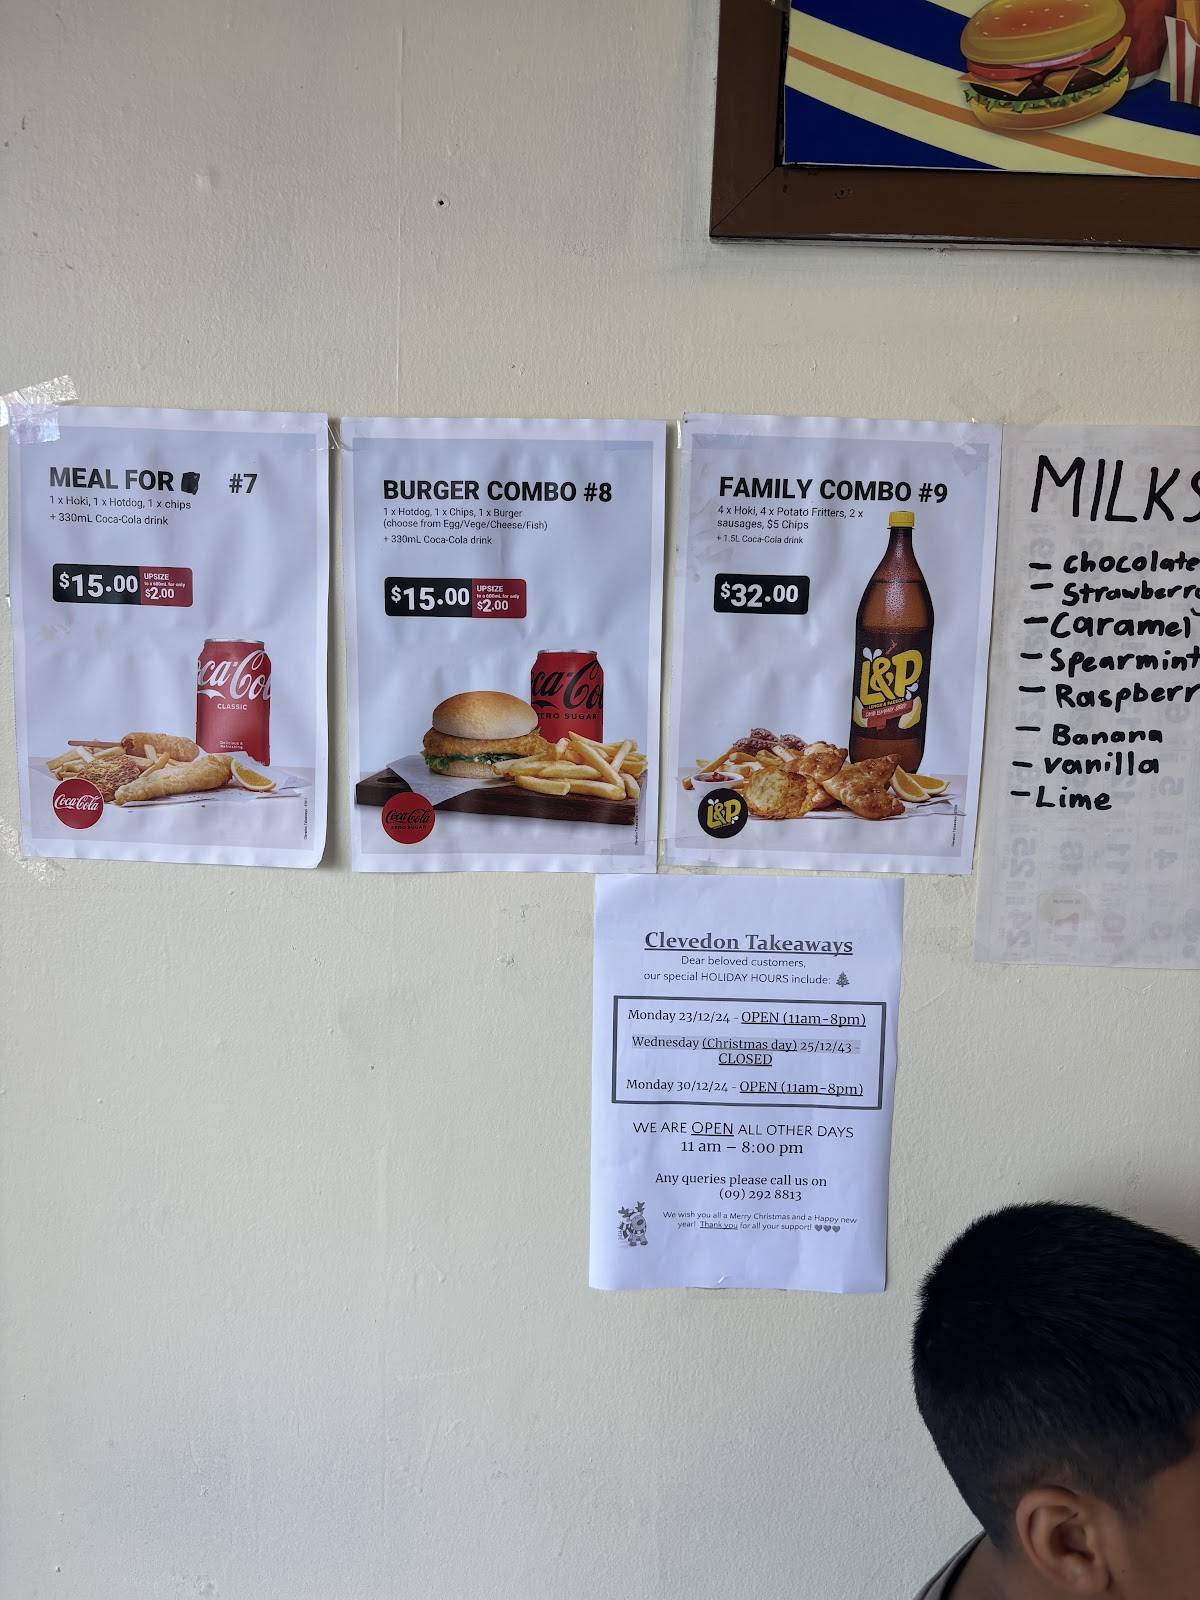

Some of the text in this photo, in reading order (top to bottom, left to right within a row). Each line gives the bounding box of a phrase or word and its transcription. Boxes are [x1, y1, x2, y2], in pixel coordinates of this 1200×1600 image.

[50, 467, 258, 494] MEAL FOR #7
[383, 480, 612, 502] BURGER COMBO #8
[719, 476, 948, 503] FAMILY COMBO #9
[50, 495, 54, 504] 1
[66, 496, 91, 507] Hoki,
[93, 498, 98, 506] 1
[109, 498, 145, 509] Hotdog,
[165, 500, 192, 511] chips
[59, 513, 92, 523] 330mL
[95, 514, 142, 524] Coca-Cola
[144, 516, 169, 525] drink
[384, 507, 388, 516] 1
[399, 507, 432, 518] Hotdog,
[435, 508, 439, 516] 1
[449, 508, 476, 518] Chips,
[479, 508, 483, 517] 1
[494, 508, 523, 519] Burger
[717, 505, 724, 514] 4
[734, 506, 758, 517] Hoki,
[760, 507, 766, 515] 4
[777, 507, 809, 516] Potato
[812, 508, 847, 519] Fritters,
[849, 509, 855, 518] 2
[383, 519, 548, 531] (choose from Egg/Vege/Cheese/Fish)
[717, 519, 809, 531] sausages, $5 Chips
[391, 535, 421, 544] 330mL
[424, 535, 468, 544] Coca-Cola
[470, 536, 492, 545] drink
[724, 535, 740, 543] 1.5L
[742, 535, 782, 544] Coca-Cola
[784, 536, 803, 544] drink
[59, 571, 139, 598] $15.00
[145, 587, 174, 600] $2.00
[391, 585, 470, 611] $15.00
[720, 582, 799, 607] $32.00
[477, 599, 509, 612] $2.00
[1050, 612, 1190, 639] Caramel
[1050, 645, 1200, 677] Spearmint
[860, 649, 922, 705] L&P
[217, 703, 248, 711] CLASSIC
[1052, 723, 1163, 745] Banana
[1036, 786, 1112, 810] Lime
[706, 799, 741, 828] L&P
[644, 931, 853, 957] Clevedon Takeaways
[681, 955, 806, 968] Dear beloved customers,
[644, 971, 831, 984] our special HOLIDAY HOURS include:
[628, 1009, 676, 1023] Monday
[679, 1011, 729, 1024] 23/12/24
[741, 1011, 779, 1023] OPEN
[632, 1036, 699, 1050] Wednesday
[702, 1037, 768, 1050] (Christmas
[771, 1039, 797, 1052] day)
[800, 1041, 852, 1053] 25/12/43
[718, 1052, 772, 1065] CLOSED
[626, 1079, 674, 1092] Monday
[677, 1081, 728, 1092] 30/12/24
[740, 1081, 777, 1092] OPEN
[632, 1122, 854, 1138] WE ARE OPEN ALL OTHER DAYS
[681, 1141, 693, 1152] 11
[698, 1144, 721, 1152] am
[741, 1141, 775, 1154] 8:00
[779, 1144, 803, 1156] pm
[655, 1173, 827, 1187] Any queries please call us on
[719, 1189, 802, 1201] (09) 292 8813
[729, 1213, 751, 1221] Merry
[753, 1212, 790, 1220] Christmas
[814, 1214, 839, 1224] Happy
[677, 1221, 695, 1229] year!
[700, 1220, 722, 1228] Thank
[724, 1222, 738, 1230] you
[740, 1221, 750, 1229] for
[762, 1223, 779, 1231] your
[781, 1222, 812, 1231] support!
